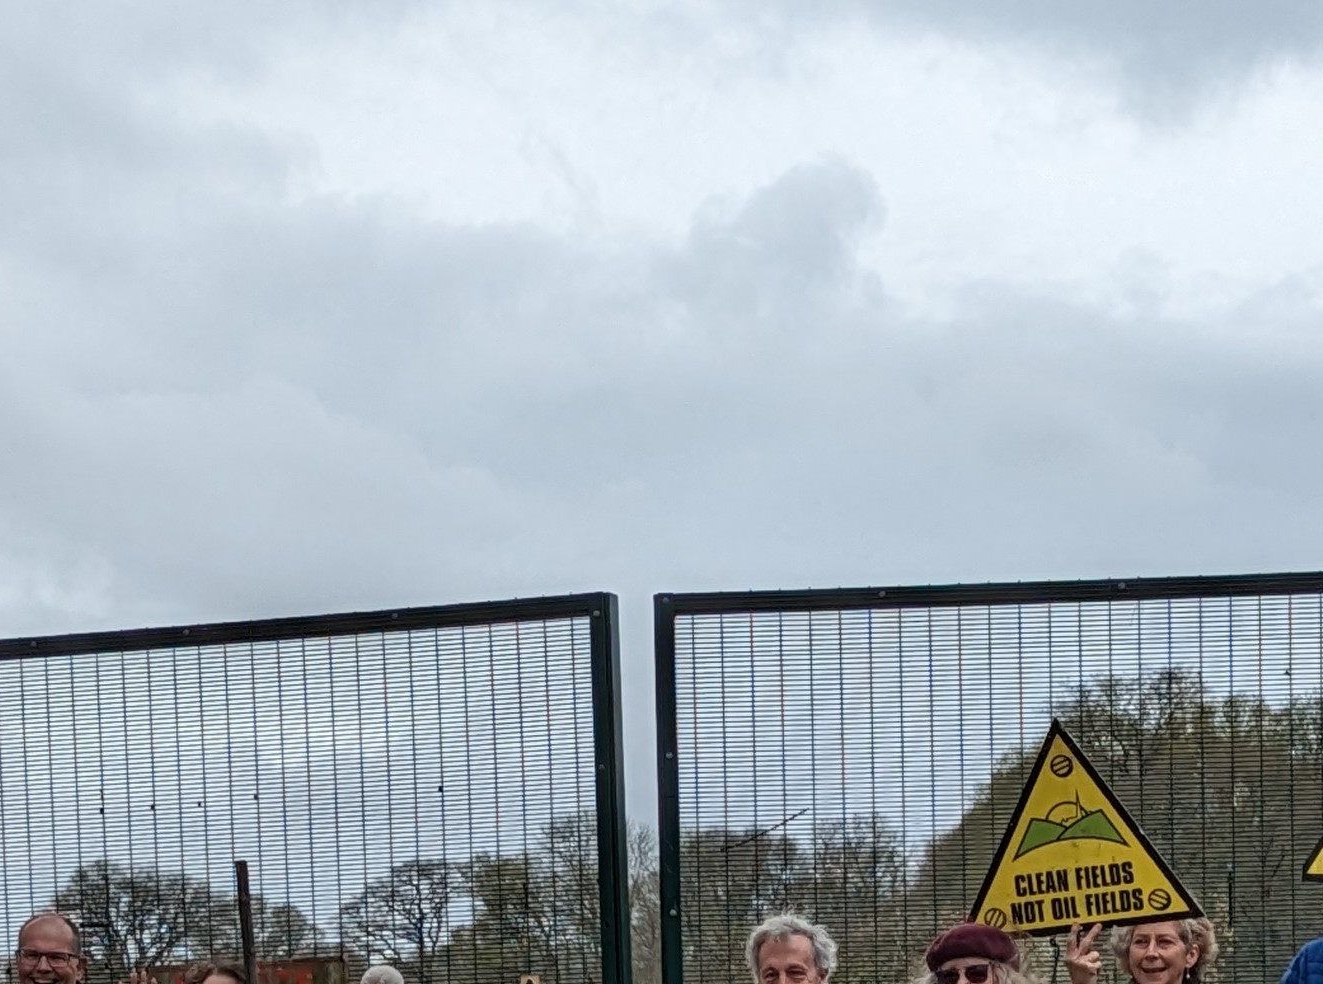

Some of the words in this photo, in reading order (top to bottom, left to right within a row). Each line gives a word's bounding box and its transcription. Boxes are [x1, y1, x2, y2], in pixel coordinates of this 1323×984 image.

[1014, 869, 1070, 897] CLEAN
[1076, 861, 1135, 890] FIELDS
[1010, 900, 1046, 926] NOT
[1052, 896, 1081, 922] OIL
[1085, 888, 1145, 916] FIELDS
